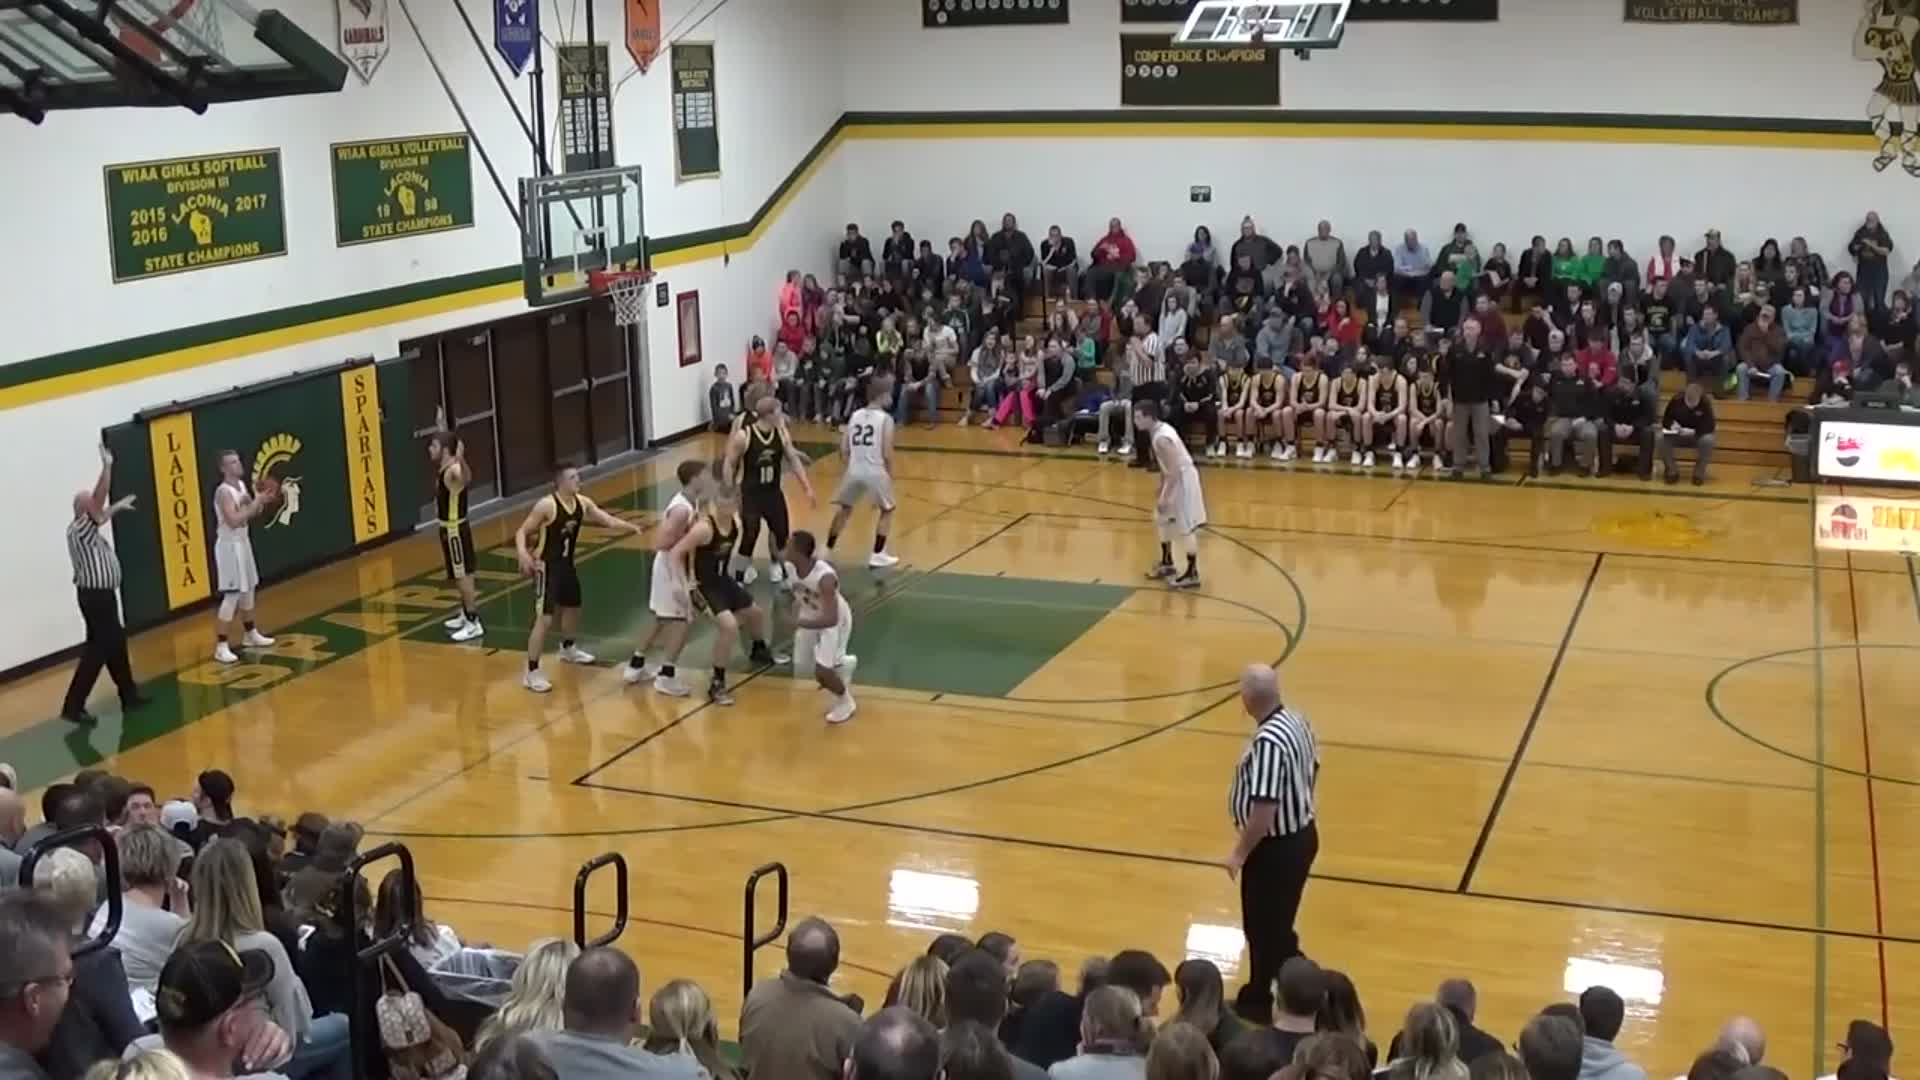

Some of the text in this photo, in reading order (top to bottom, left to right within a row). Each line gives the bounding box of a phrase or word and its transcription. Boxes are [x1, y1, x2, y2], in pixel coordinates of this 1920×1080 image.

[1135, 49, 1202, 62] CONFERENCE
[337, 138, 464, 160] WIAA GIRLS VOLLEYBALL
[122, 156, 267, 184] WIAA GIRLS SOFTBALL
[167, 178, 215, 194] DIVISION
[384, 171, 429, 197] LACONIA
[171, 193, 229, 224] LACONIA
[235, 194, 266, 211] 2017
[130, 207, 166, 226] 2015
[362, 214, 453, 238] STATE CHAMPIONS
[132, 227, 167, 246] 2016
[144, 242, 259, 271] STATE CHAMPIONS
[852, 424, 873, 446] 22
[354, 374, 377, 534] SPARTANS
[166, 432, 196, 587] LACONIA
